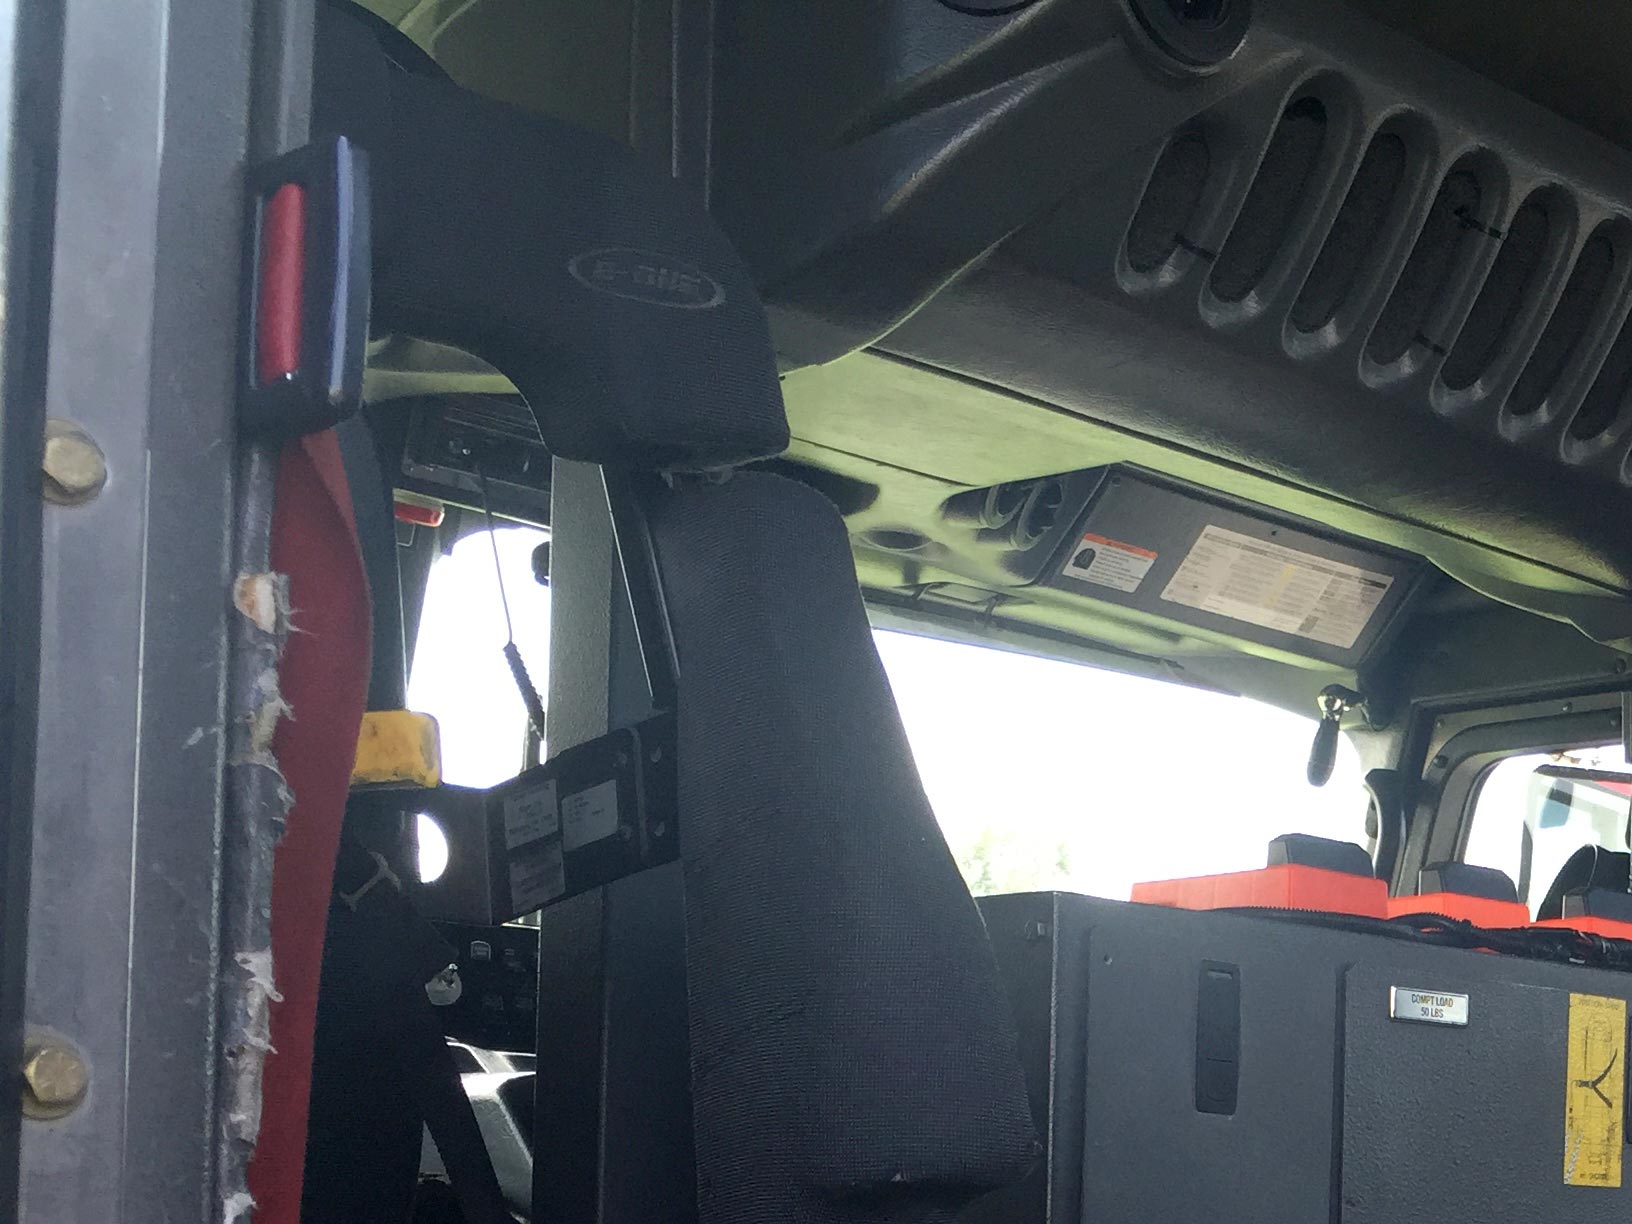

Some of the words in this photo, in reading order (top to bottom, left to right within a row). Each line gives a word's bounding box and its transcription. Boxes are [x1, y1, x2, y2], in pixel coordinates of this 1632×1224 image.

[1411, 993, 1435, 1006] COMPT
[1435, 995, 1454, 1008] LOAD
[1420, 1006, 1430, 1017] 50
[1430, 1007, 1444, 1018] LBS
